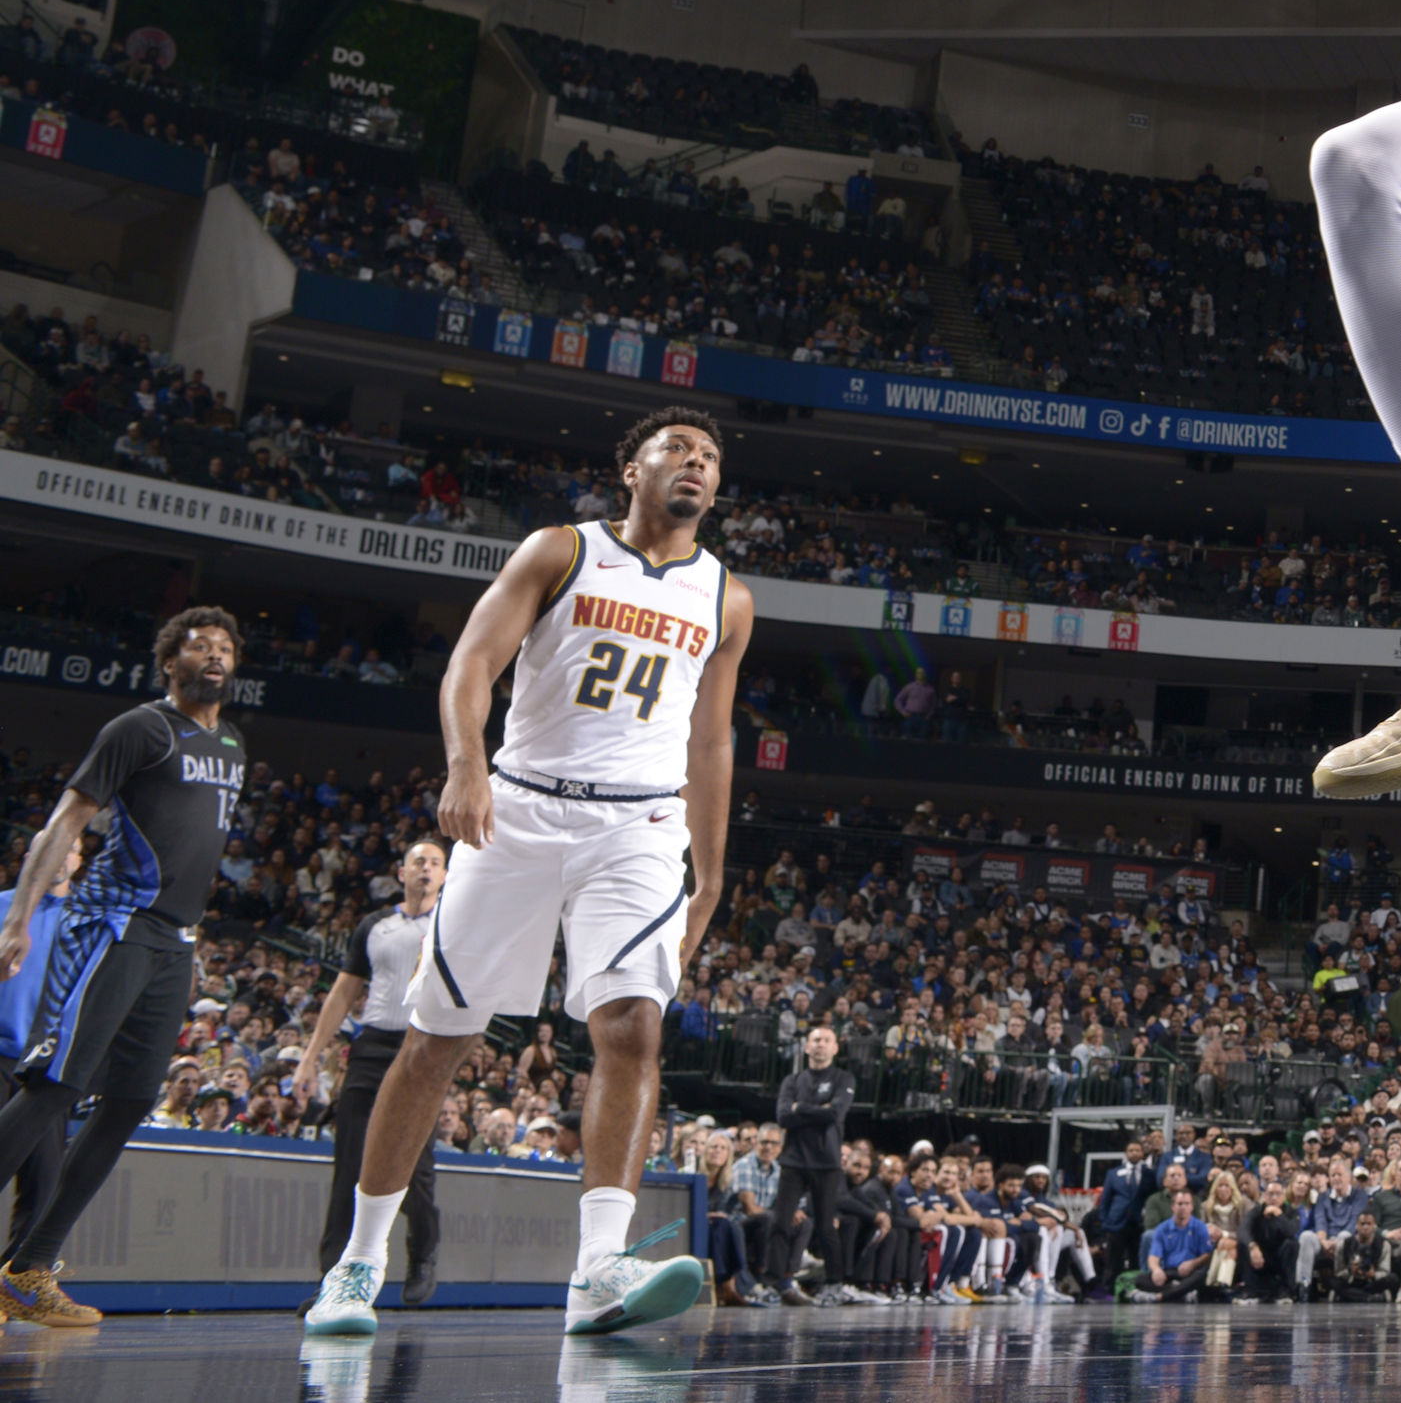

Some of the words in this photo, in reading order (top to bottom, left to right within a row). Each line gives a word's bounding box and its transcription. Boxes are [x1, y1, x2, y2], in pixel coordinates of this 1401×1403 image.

[333, 46, 365, 67] DO
[885, 382, 1086, 430] WWW.DRINKRYSE.COM
[1177, 417, 1288, 450] @DRINKRYSE
[36, 469, 128, 506] OFFICIAL
[137, 489, 209, 521] ENERGY
[219, 507, 276, 533] DRINK
[285, 518, 305, 538] OF
[316, 523, 348, 547] THE
[358, 527, 444, 565] DALLAS
[676, 579, 710, 598] ibotta
[572, 594, 710, 658] NUGGETS
[574, 641, 670, 722] 24
[181, 754, 245, 790] DALLAS
[1043, 763, 1117, 786] OFFICIAL
[1124, 769, 1185, 790] ENERGY
[1191, 773, 1241, 794] DRINK
[1248, 776, 1268, 794] OF
[1275, 777, 1303, 795] THE
